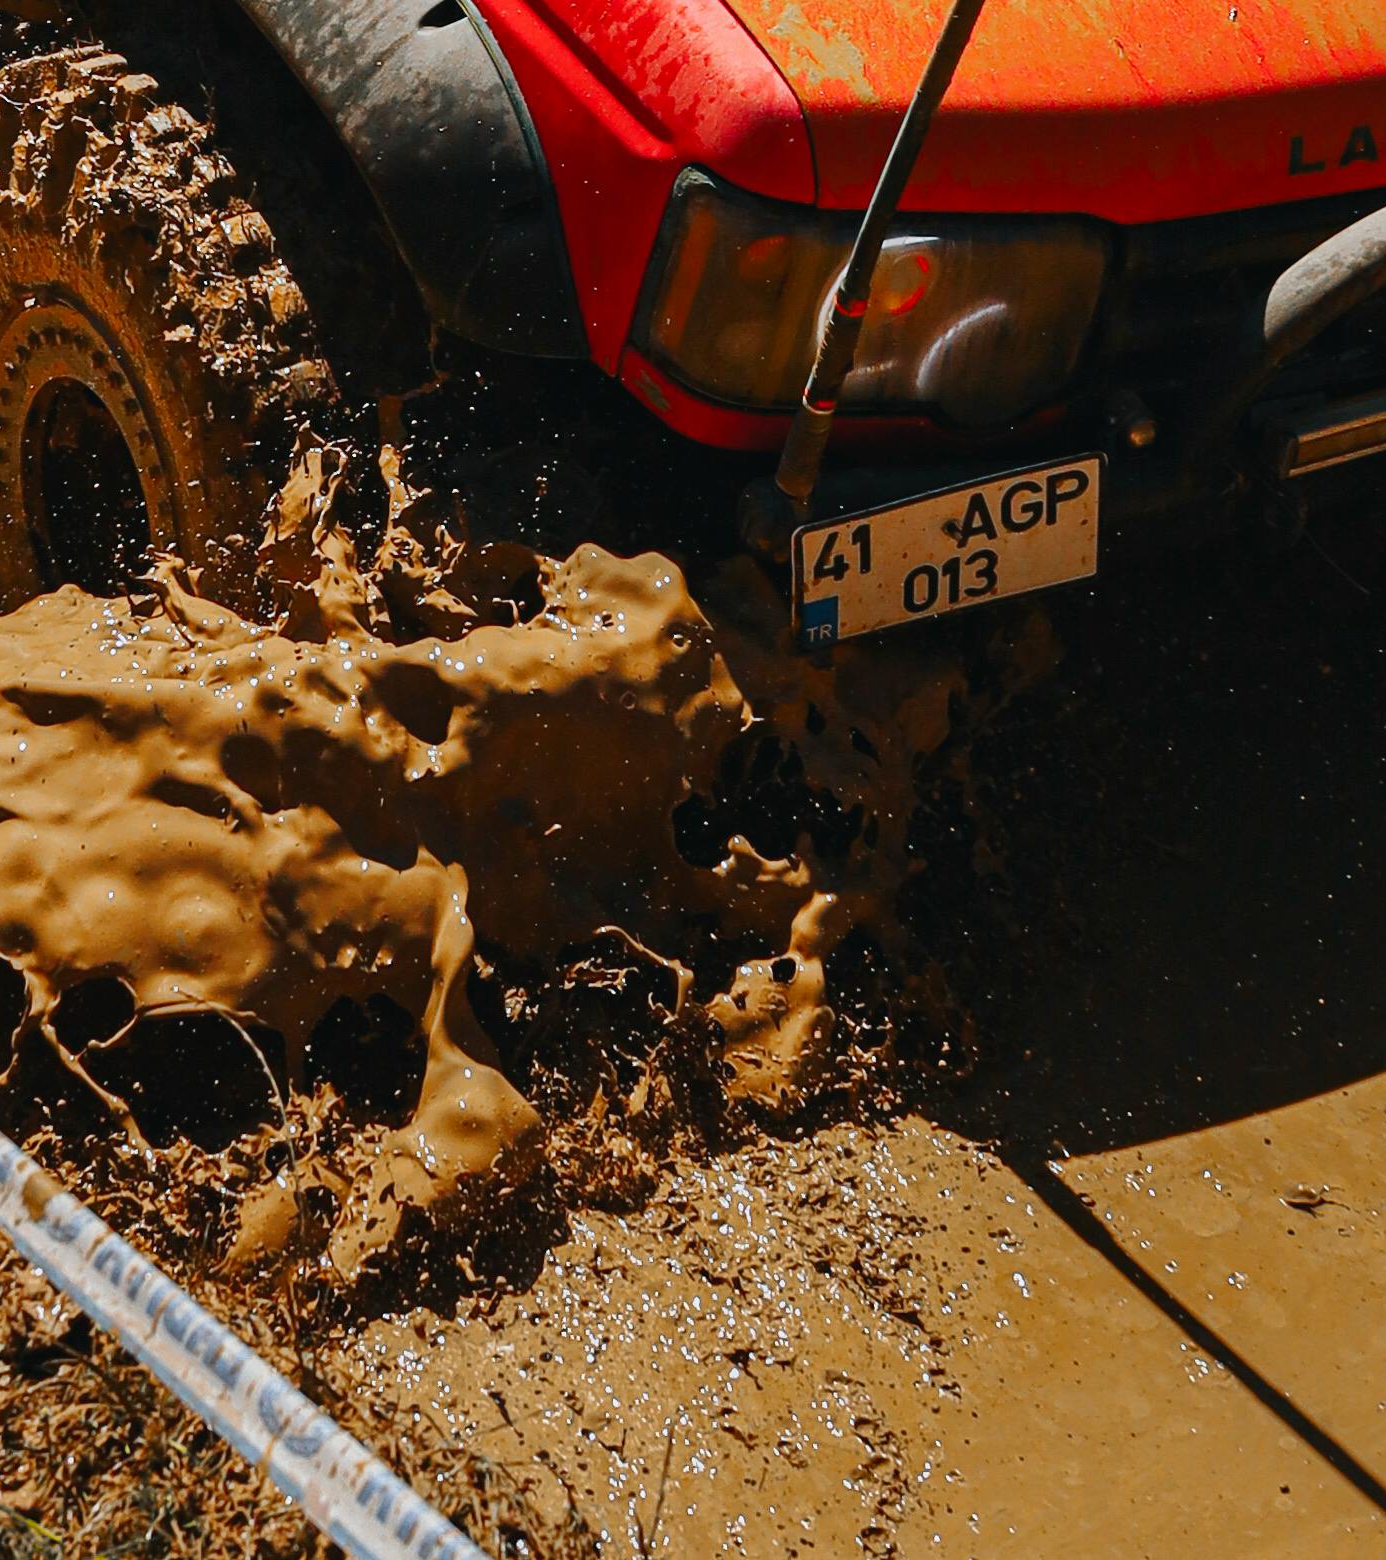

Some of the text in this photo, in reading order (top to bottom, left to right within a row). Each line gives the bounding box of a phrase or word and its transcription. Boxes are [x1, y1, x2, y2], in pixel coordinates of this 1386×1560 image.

[813, 468, 1090, 582] 41 AGP
[902, 548, 999, 614] 013
[806, 623, 833, 643] TR
